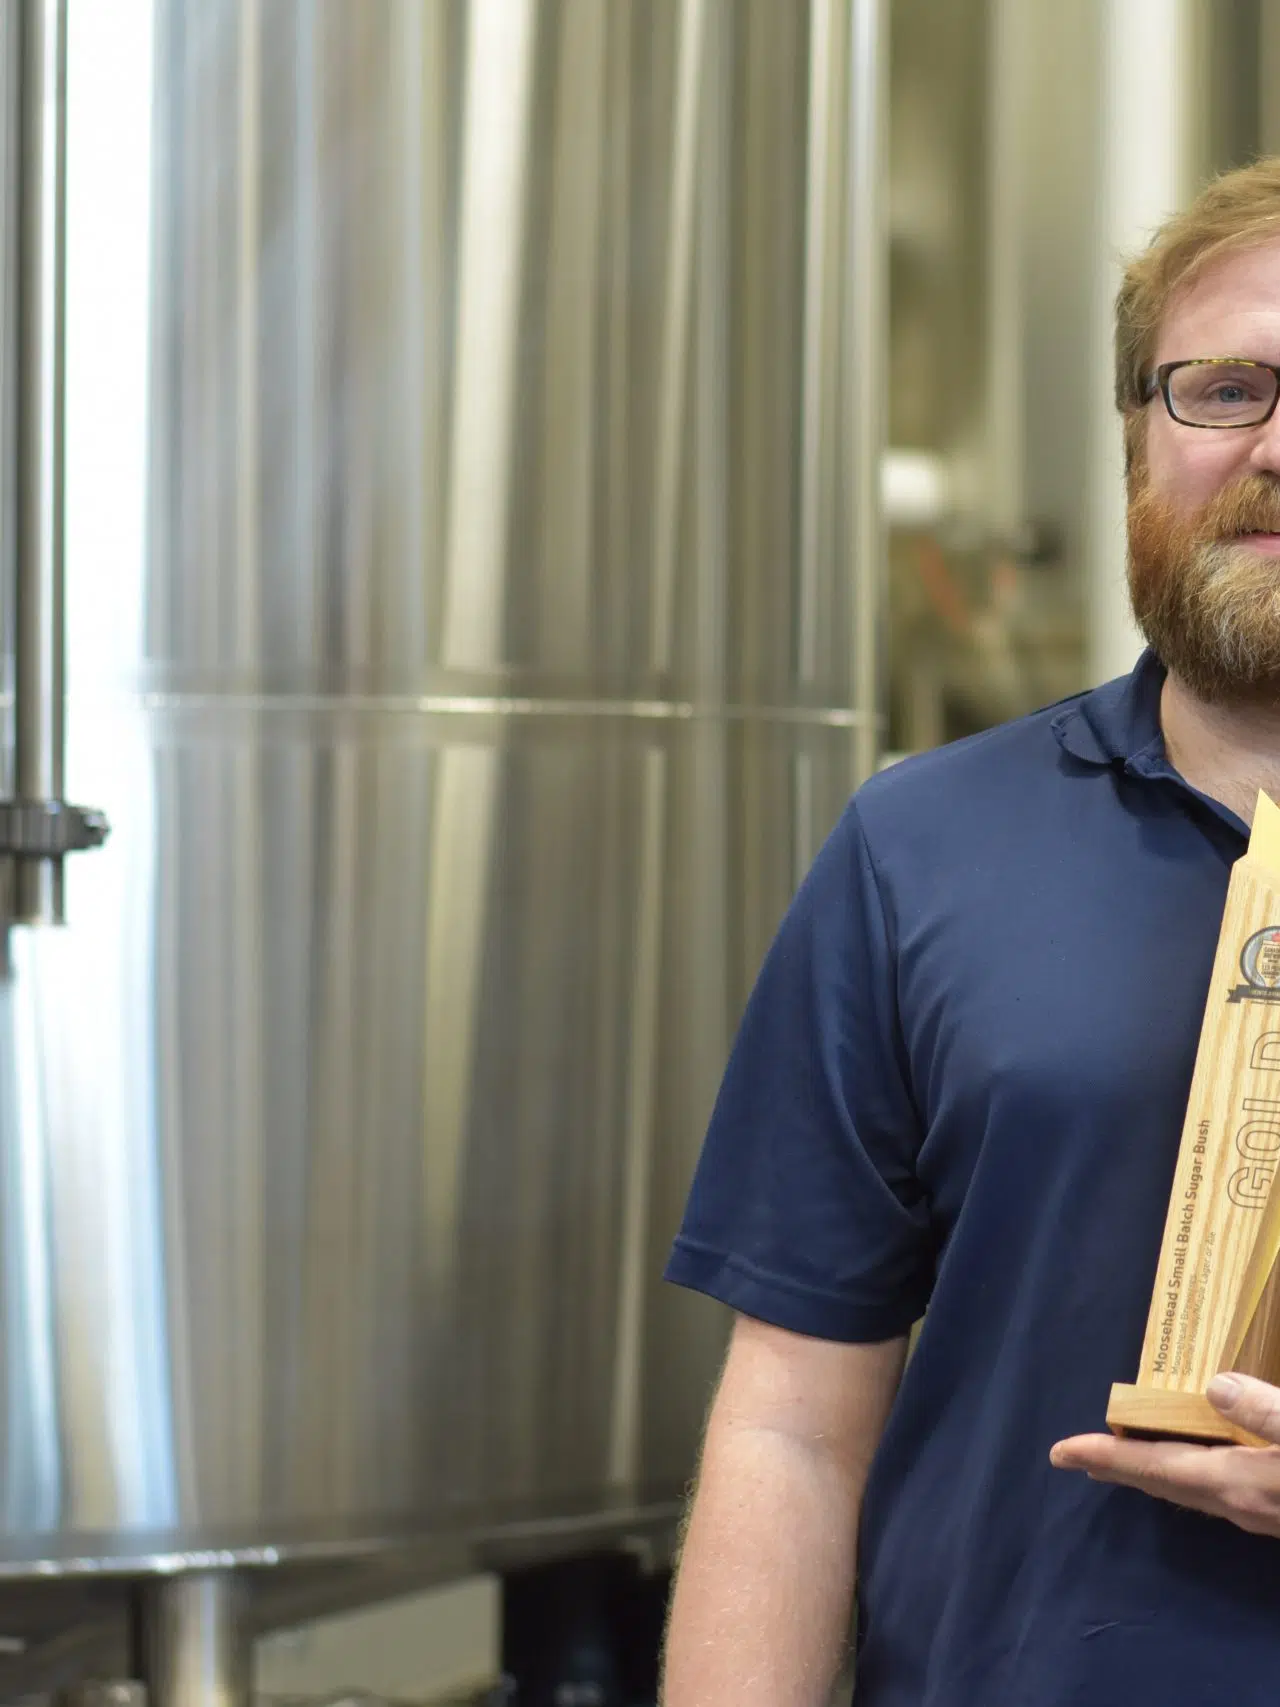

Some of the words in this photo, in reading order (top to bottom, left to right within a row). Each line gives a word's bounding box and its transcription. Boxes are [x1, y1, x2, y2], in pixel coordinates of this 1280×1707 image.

[1194, 1118, 1209, 1153] Bush
[1186, 1157, 1203, 1200] Sugar
[1177, 1202, 1194, 1243] Batch
[1168, 1246, 1186, 1289] Small
[1153, 1291, 1177, 1373] Moosehead
